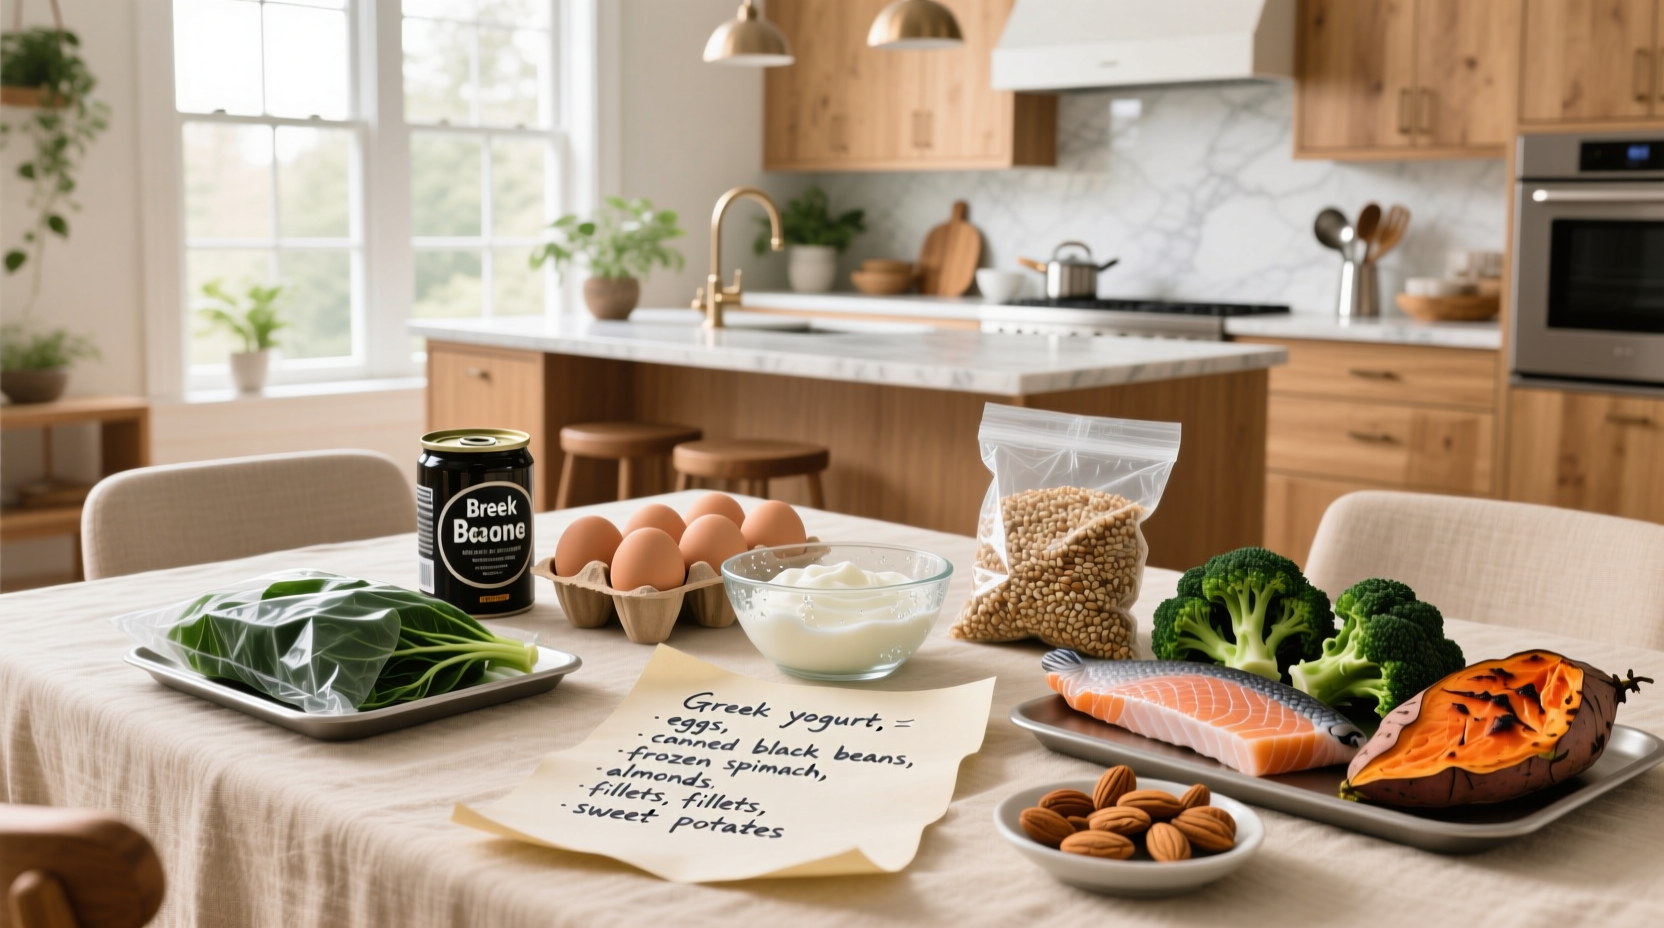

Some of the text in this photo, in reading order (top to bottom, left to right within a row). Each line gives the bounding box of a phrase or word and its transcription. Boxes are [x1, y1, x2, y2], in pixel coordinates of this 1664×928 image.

[466, 495, 517, 518] Breek
[683, 691, 771, 718] Greek
[667, 716, 729, 734] eggs,
[626, 747, 711, 768] frozen
[651, 732, 914, 769] canned black beans,
[588, 781, 766, 816] fillets, fillets,
[572, 801, 784, 839] sweet potates
